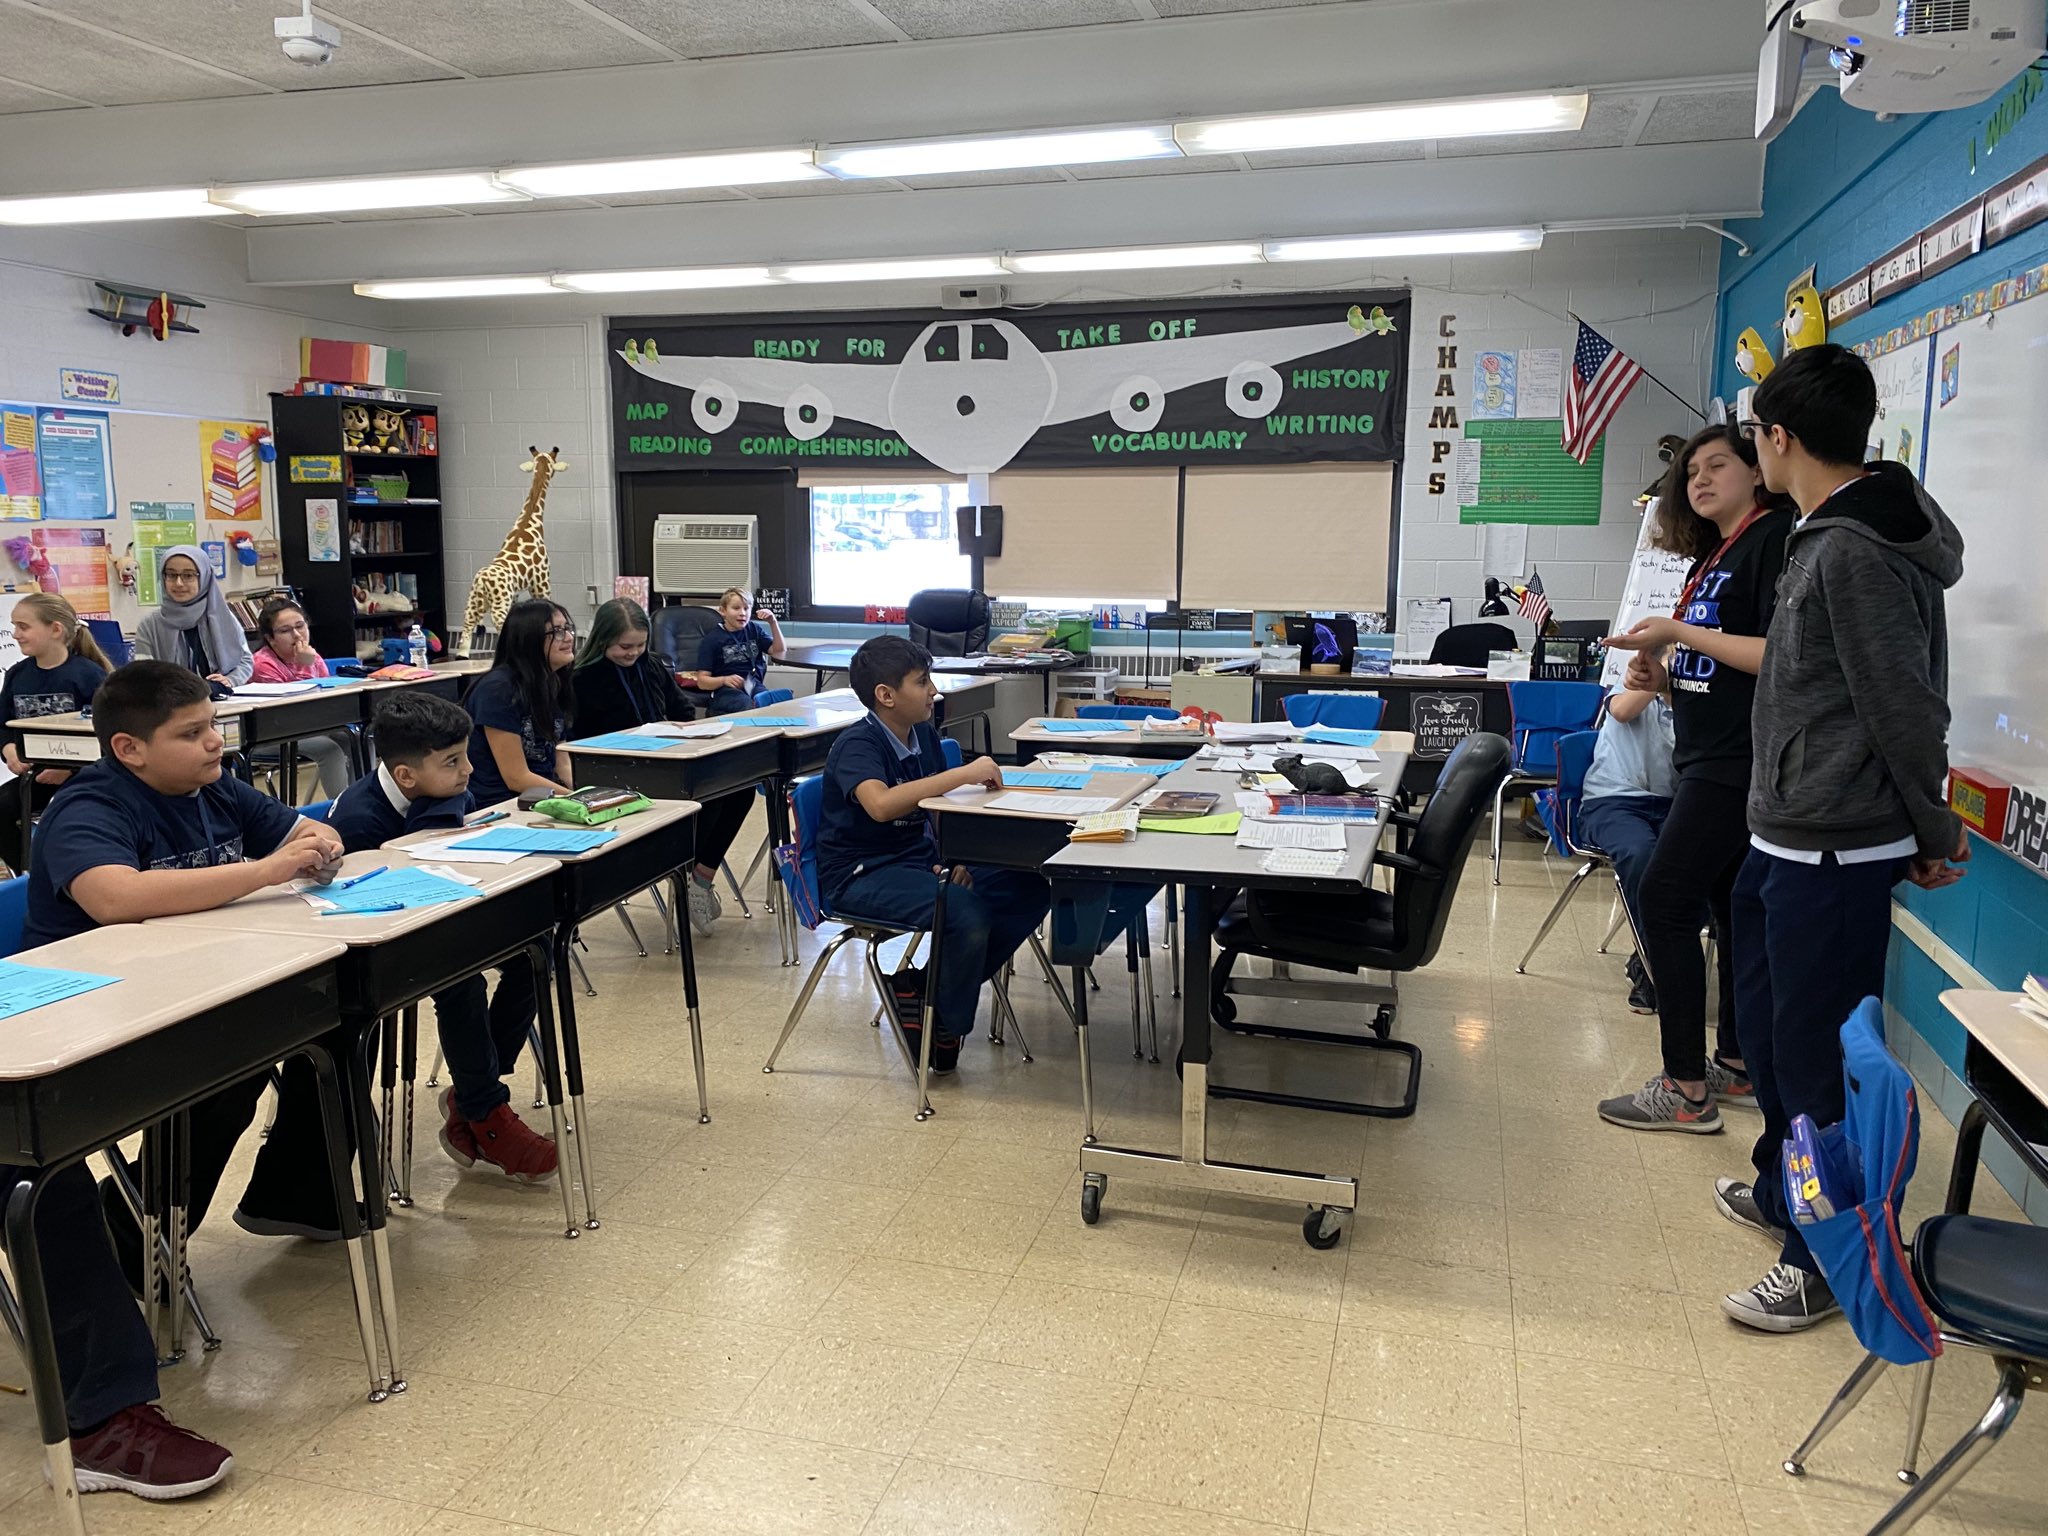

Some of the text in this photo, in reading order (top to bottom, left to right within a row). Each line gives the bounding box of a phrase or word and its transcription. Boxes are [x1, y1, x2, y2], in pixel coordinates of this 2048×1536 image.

[1904, 252, 1916, 275] Hh
[1951, 226, 1961, 250] Kk
[754, 319, 1197, 357] READY FOR TAKE OFF
[73, 373, 109, 389] Writing
[1292, 369, 1390, 392] HISTORY
[626, 403, 669, 420] MAP
[1428, 314, 1459, 495] CHAMPS
[1266, 415, 1374, 436] WRITING
[630, 437, 909, 457] READING COMPREHENSION
[1092, 431, 1247, 452] VOCABULARY
[1540, 664, 1583, 679] HAPPY
[1669, 651, 1716, 678] RLD
[1420, 727, 1475, 736] LIVE SIMPLY
[1423, 736, 1446, 747] LAUGH
[2003, 784, 2048, 873] DRE
